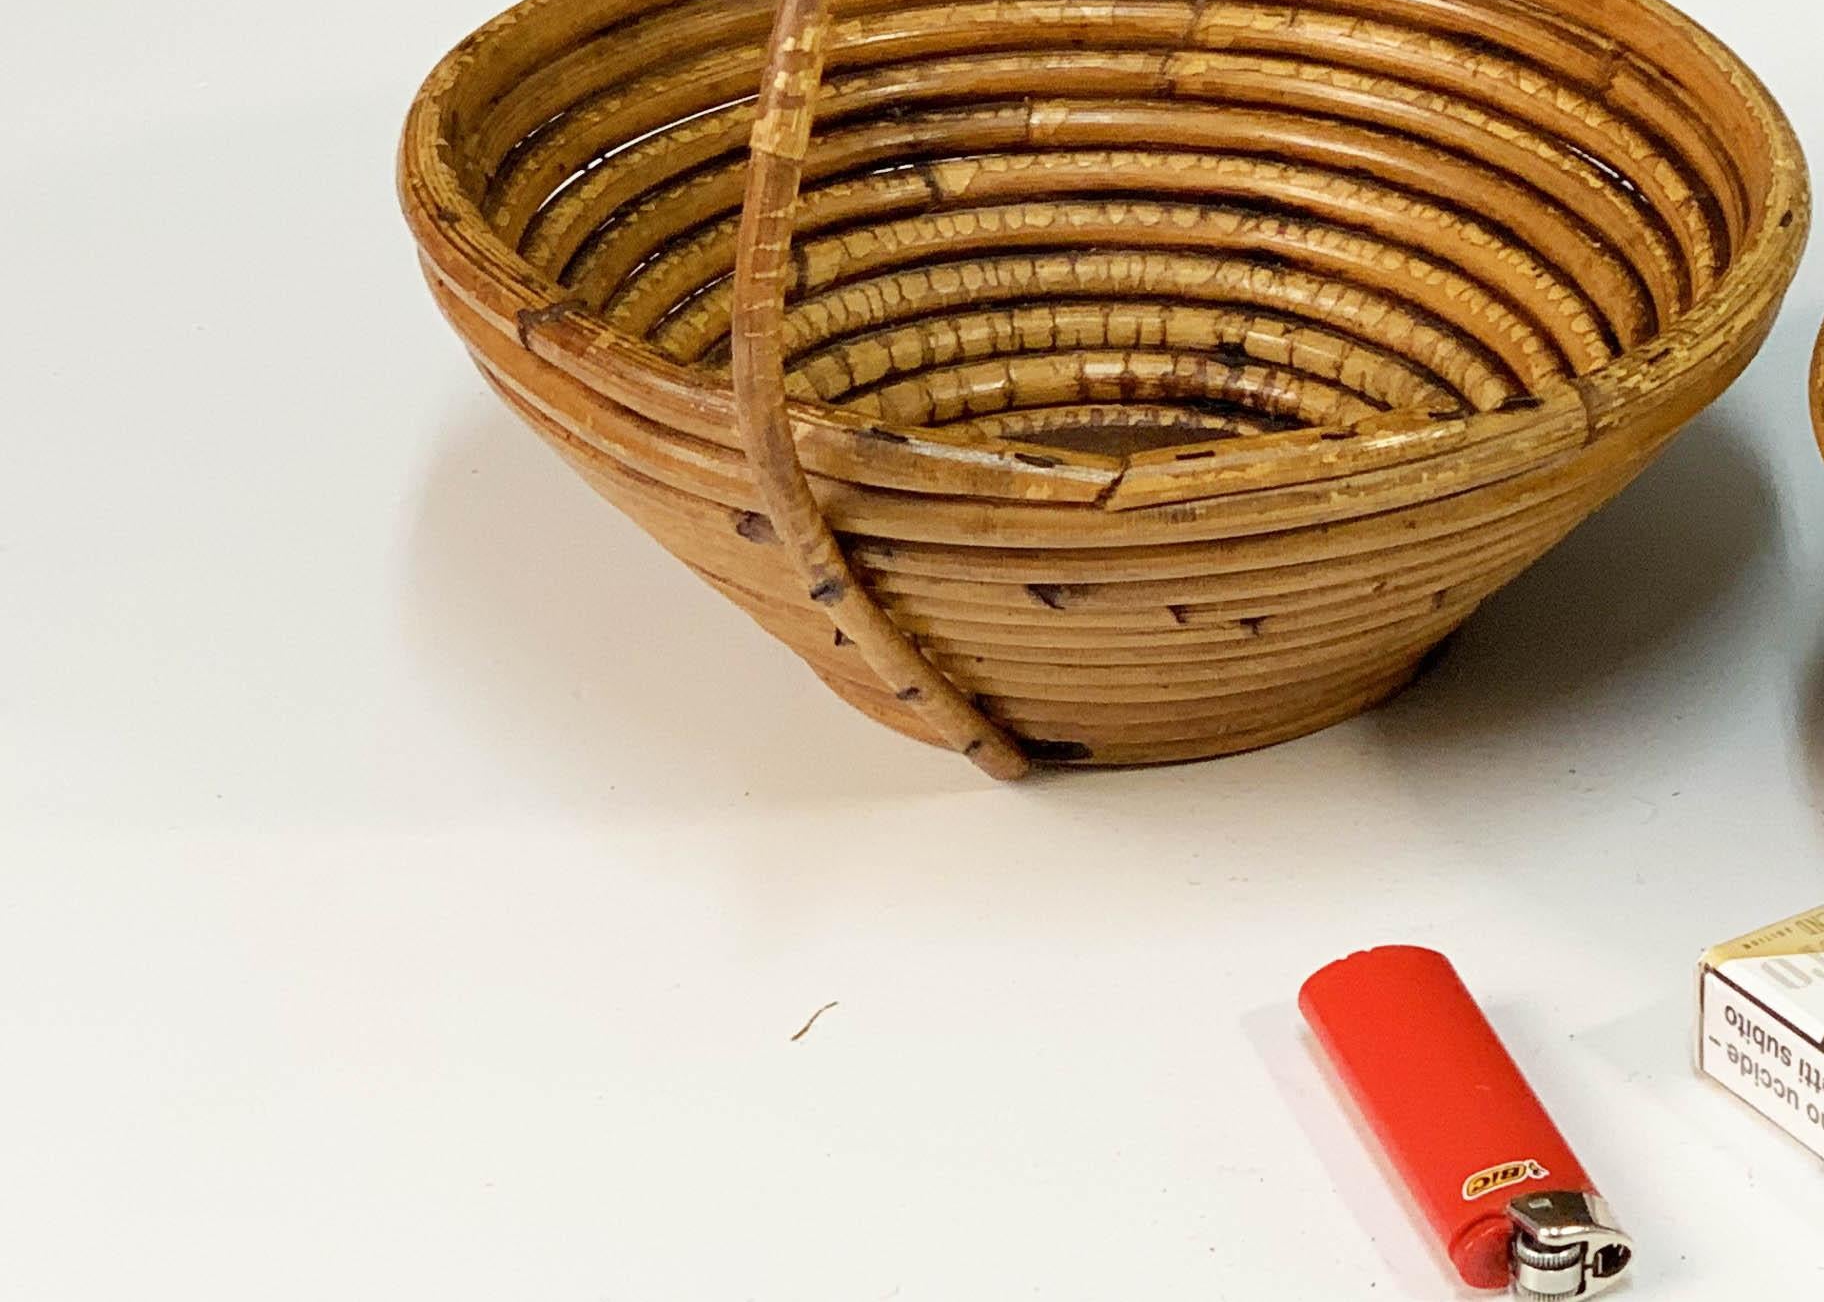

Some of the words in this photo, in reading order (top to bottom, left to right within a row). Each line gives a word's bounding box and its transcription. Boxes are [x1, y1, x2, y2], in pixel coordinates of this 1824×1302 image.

[1725, 1005, 1792, 1067] subito
[1727, 1043, 1799, 1110] uccide
[1471, 1166, 1521, 1192] BIC
